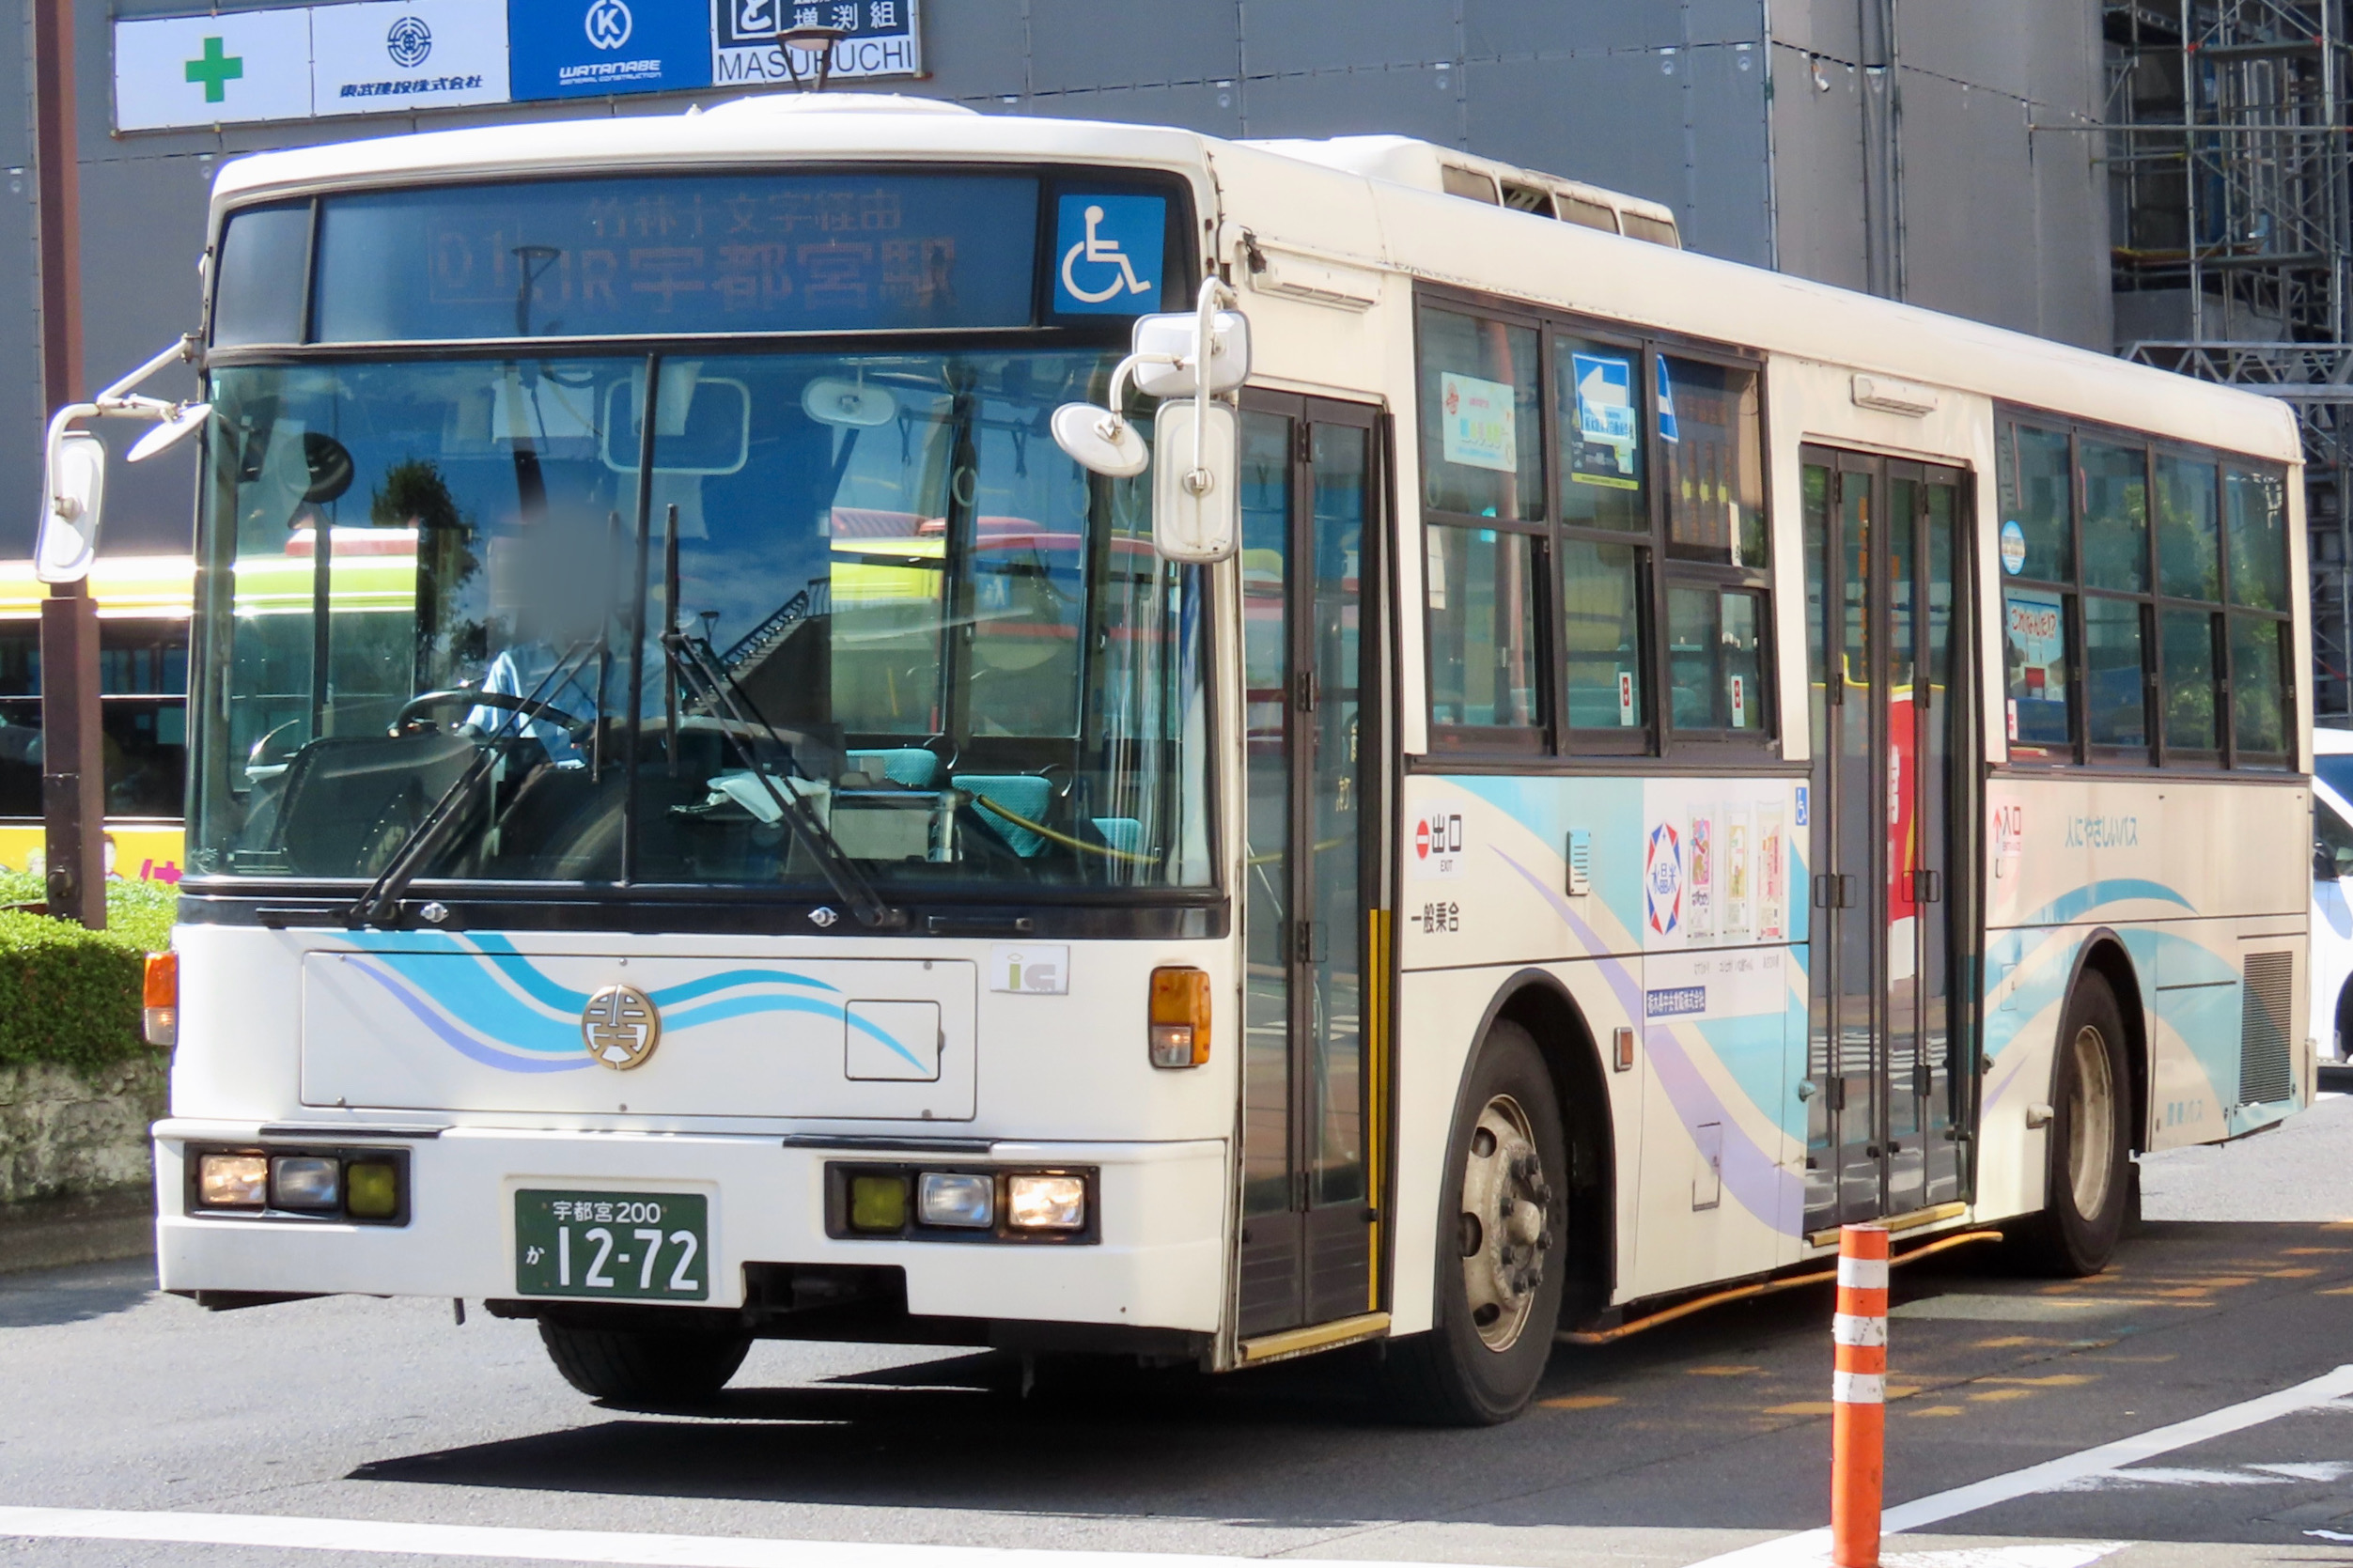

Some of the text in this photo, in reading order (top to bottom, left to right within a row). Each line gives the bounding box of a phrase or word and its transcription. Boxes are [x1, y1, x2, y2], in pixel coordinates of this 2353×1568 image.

[559, 59, 662, 79] WATANABE
[339, 75, 483, 98] 東武建設株式会社
[532, 237, 957, 315] JR宇都宮駅
[1432, 814, 1462, 854] 出口
[2002, 805, 2021, 835] 入口
[2065, 815, 2138, 848] 人にやさしいバス
[1440, 859, 1453, 872] EXIT
[1651, 862, 1677, 894] 水晶米
[1410, 901, 1459, 934] 一般乗合
[553, 1201, 662, 1224] 宇都宮200
[526, 1226, 699, 1292] か 12-72
